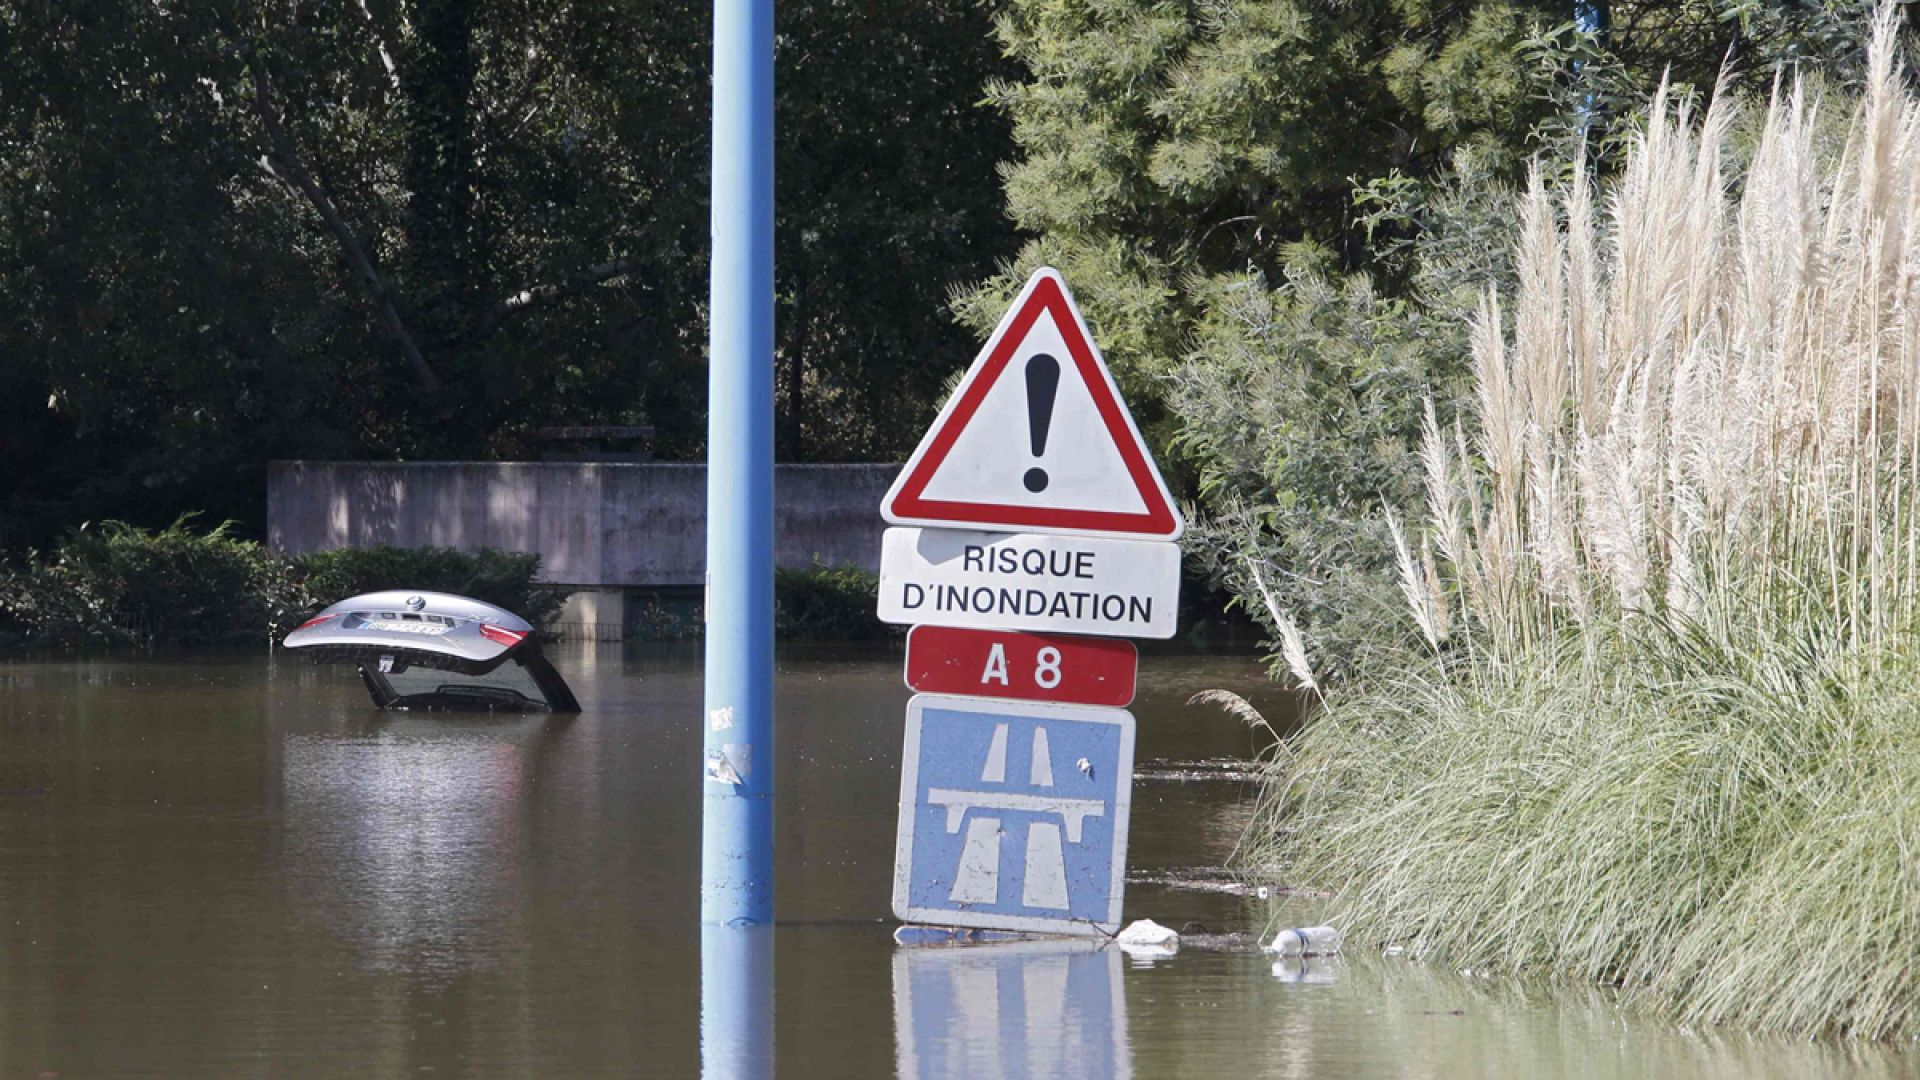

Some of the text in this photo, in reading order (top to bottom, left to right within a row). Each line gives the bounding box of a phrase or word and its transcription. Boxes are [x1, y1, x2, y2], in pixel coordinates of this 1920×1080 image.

[964, 545, 1095, 578] RISQUE
[902, 583, 1152, 623] D'INONDATION
[981, 643, 1062, 689] A 8
